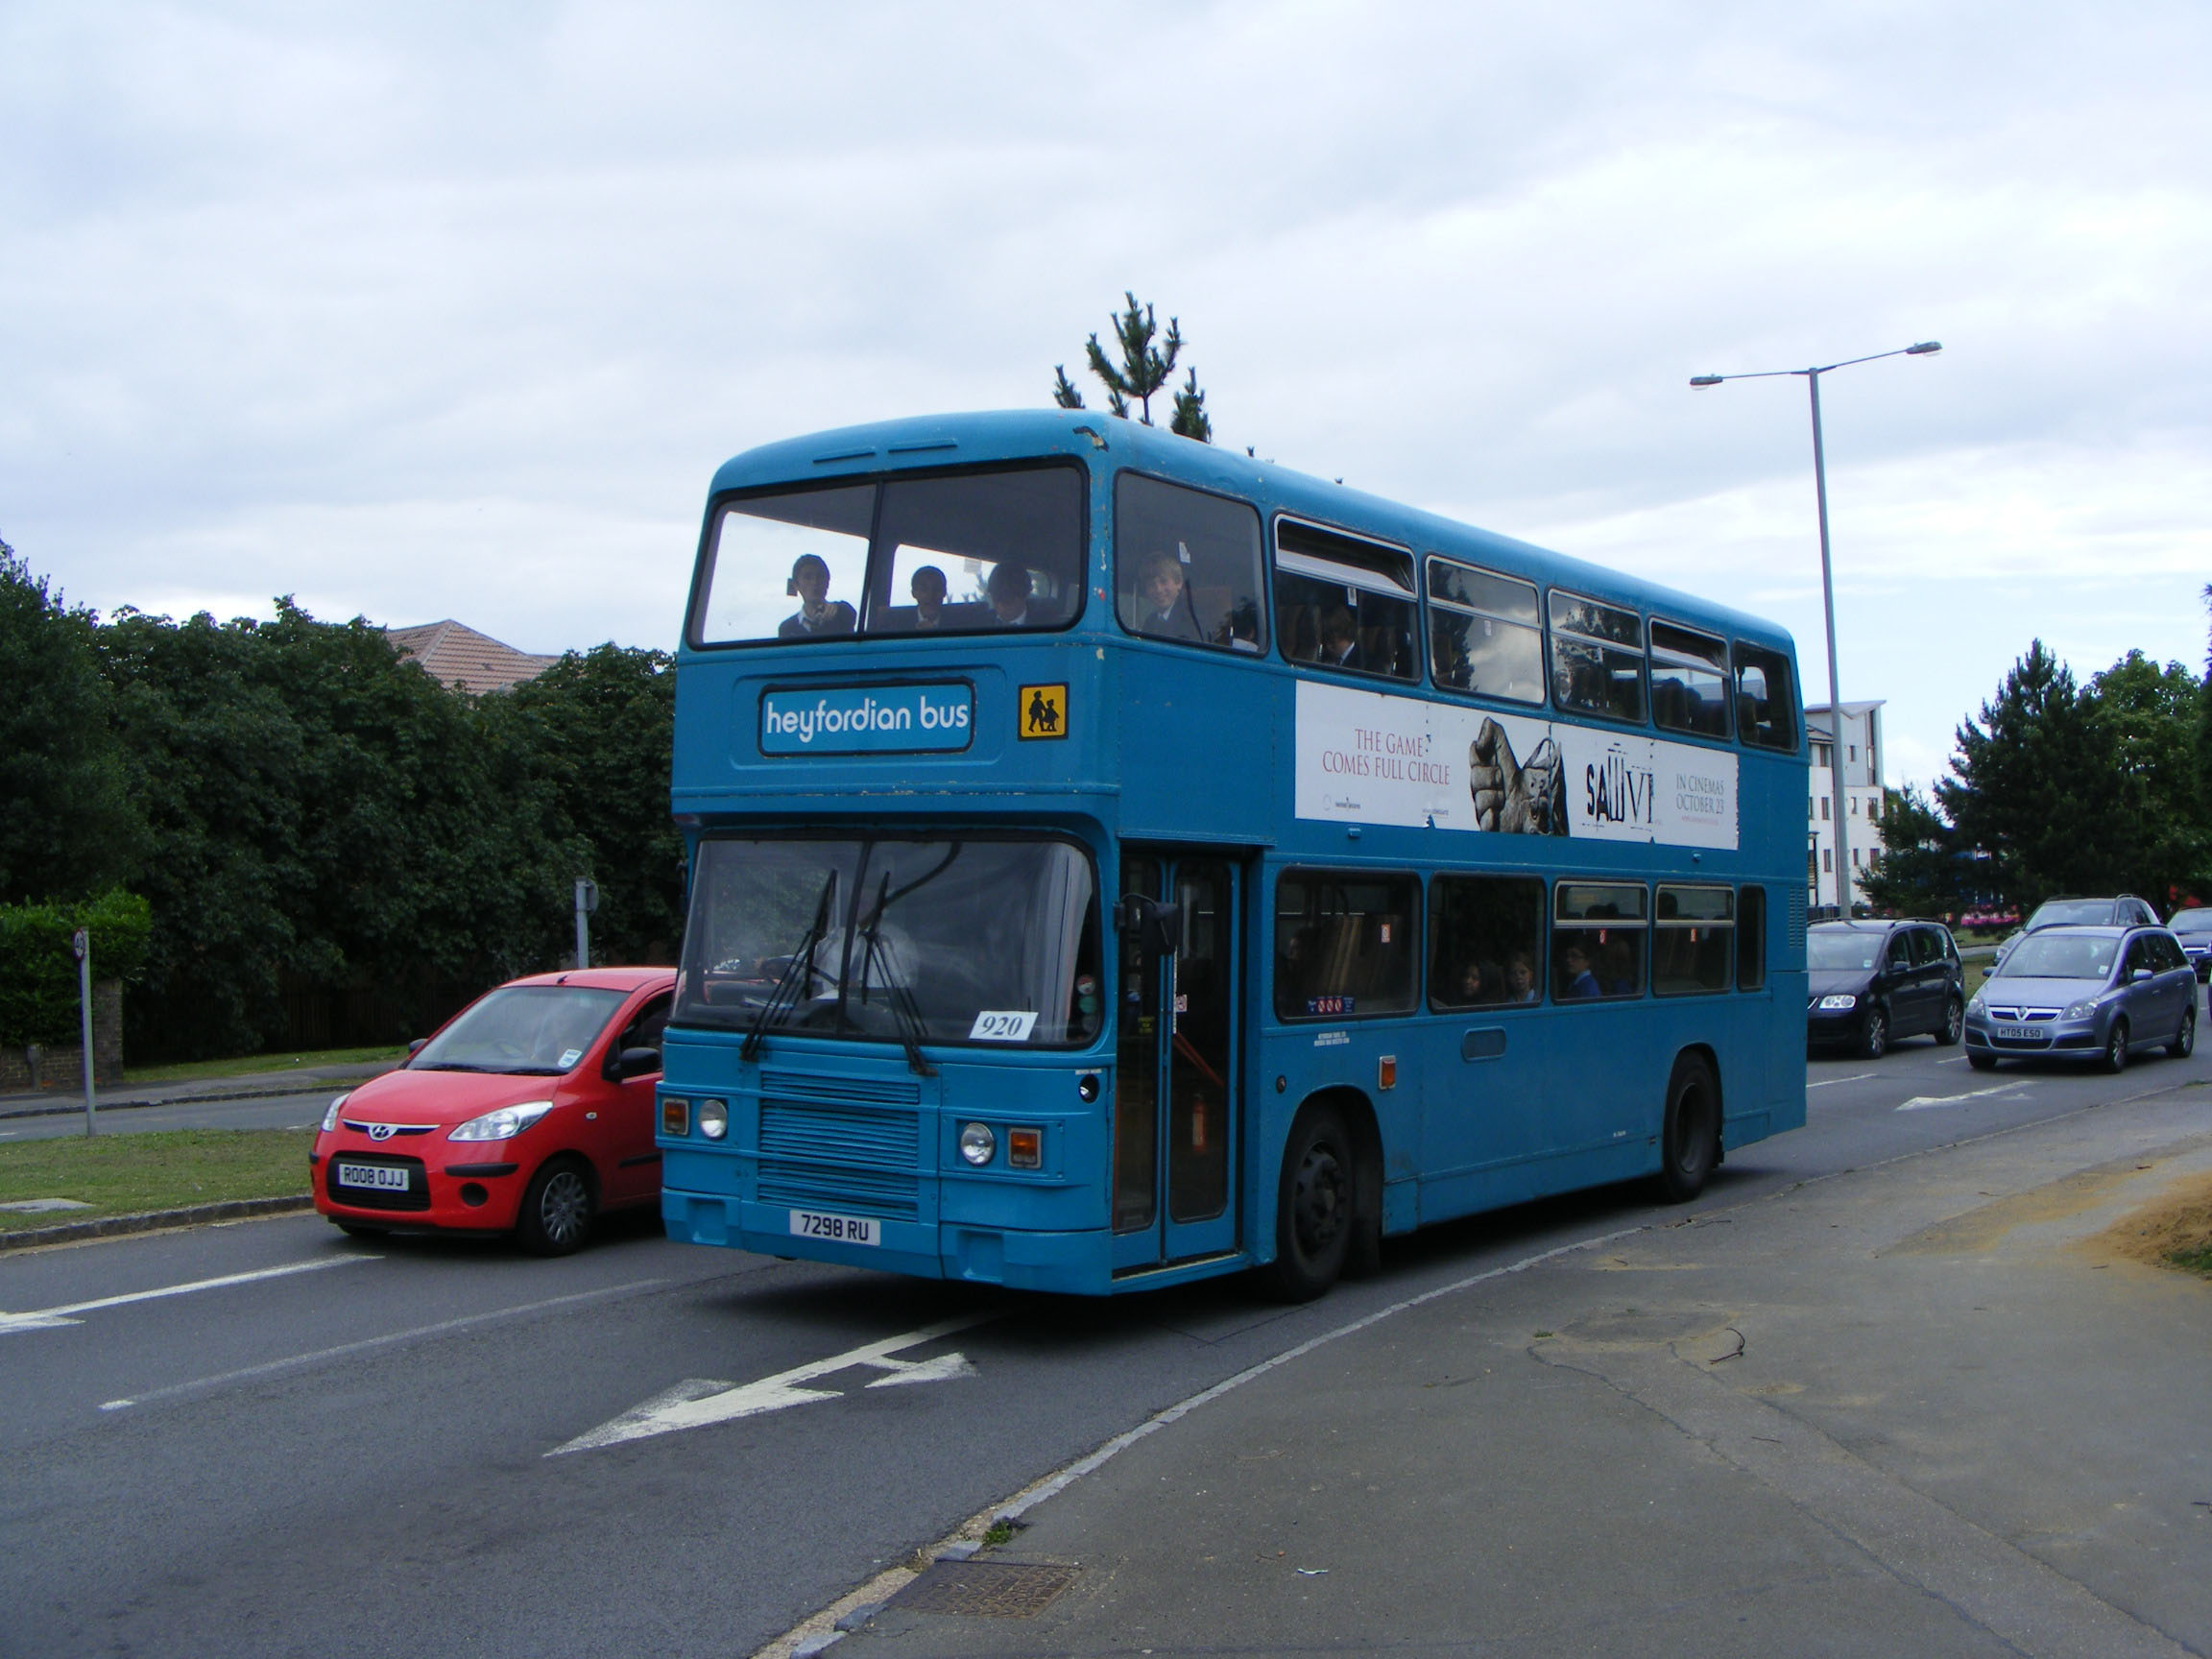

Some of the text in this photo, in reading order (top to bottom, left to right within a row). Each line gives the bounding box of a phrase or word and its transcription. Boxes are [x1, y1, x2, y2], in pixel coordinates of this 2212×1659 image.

[766, 695, 969, 743] heyfordian bus
[1355, 728, 1424, 757] THE GAME
[1322, 750, 1451, 785] COMES FULL CIRCLE
[1586, 755, 1654, 825] SAW VI
[1676, 773, 1725, 797] IN CINEMAS
[1675, 792, 1725, 815] OCTOBER 23
[980, 1016, 1023, 1037] 920
[2000, 1028, 2022, 1038] HT05
[344, 1166, 403, 1187] RO08 OJJ
[801, 1214, 869, 1241] 7298 RU
